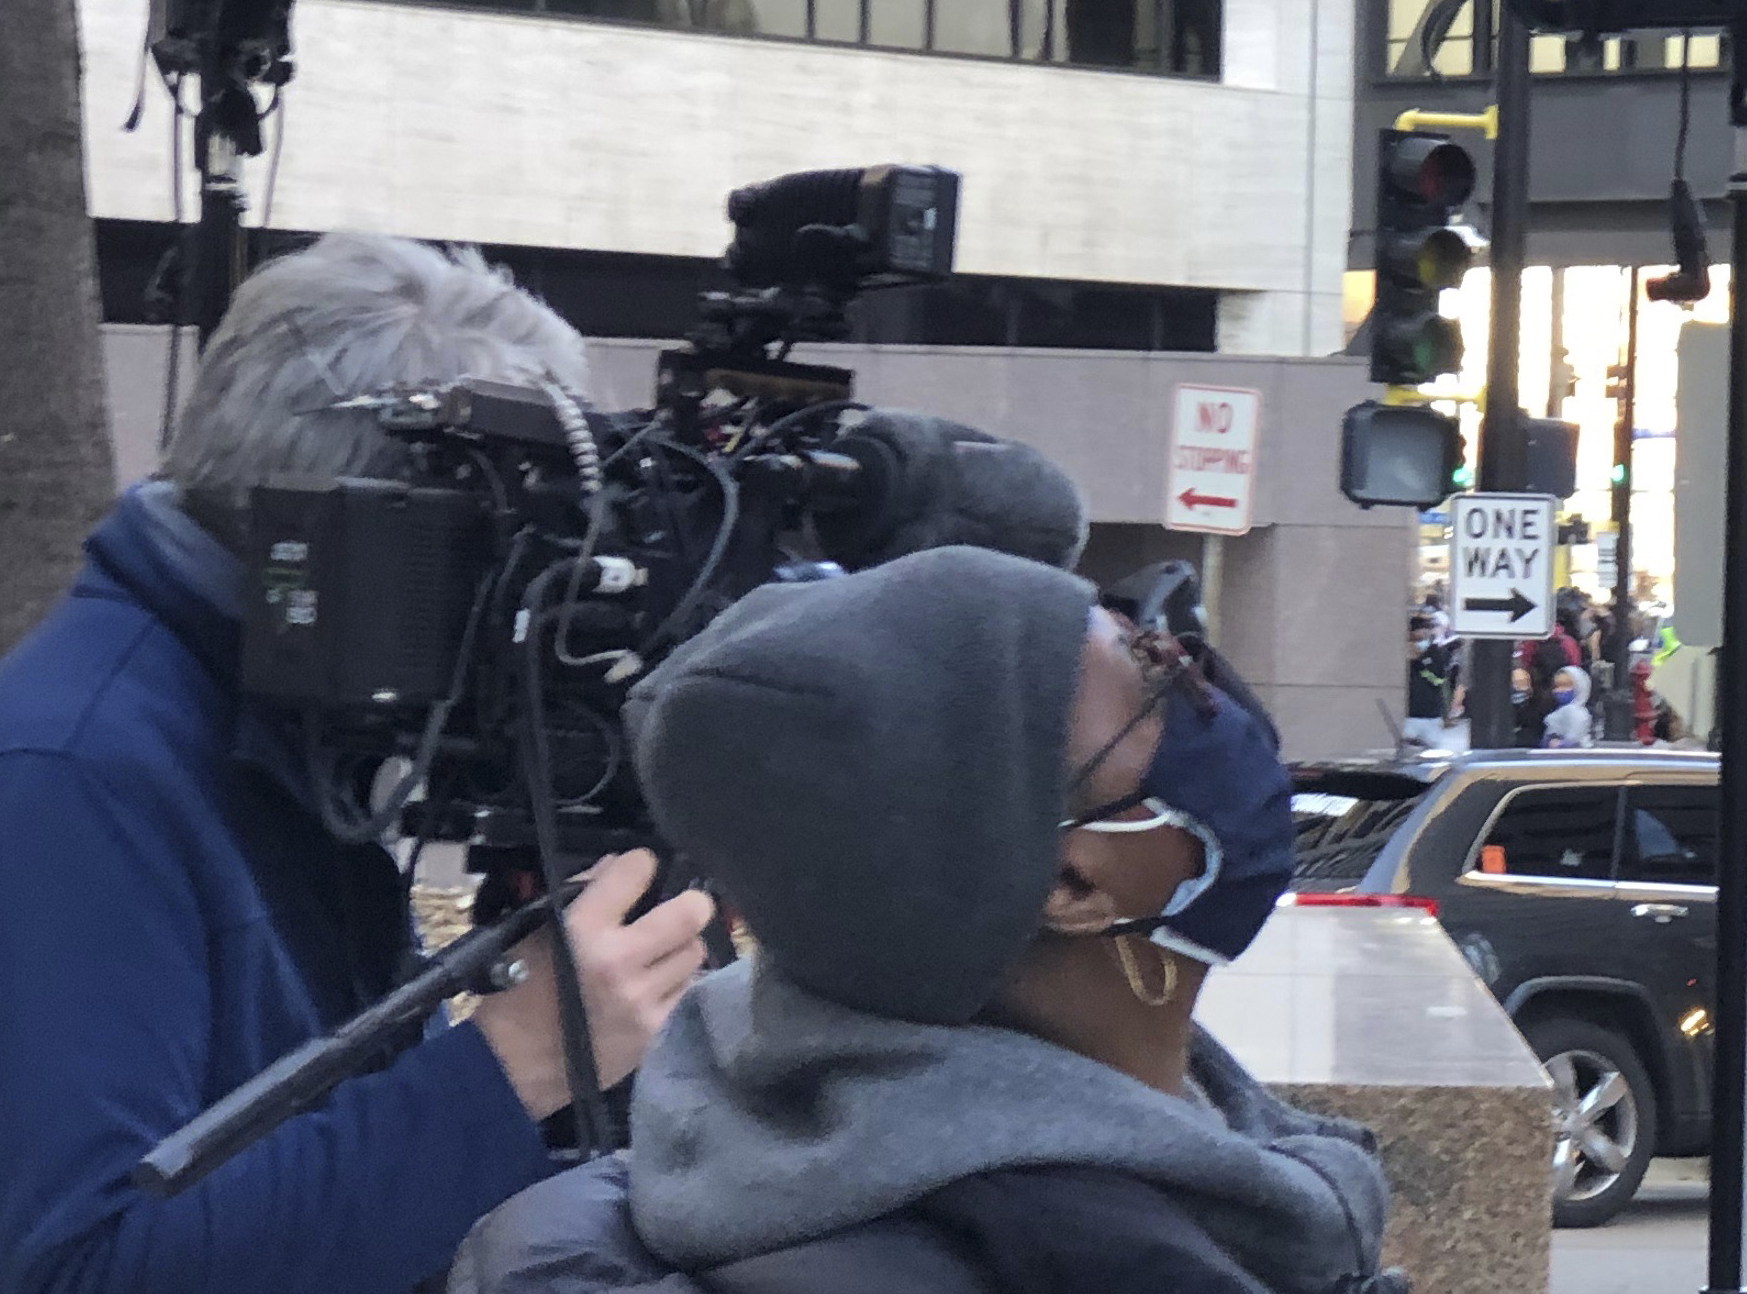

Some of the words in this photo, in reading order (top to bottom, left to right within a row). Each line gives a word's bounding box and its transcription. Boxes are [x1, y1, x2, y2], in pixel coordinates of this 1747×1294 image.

[1195, 402, 1233, 434] NO
[1175, 445, 1250, 474] STOPPING
[1465, 507, 1540, 540] ONE
[1462, 546, 1540, 579] WAY
